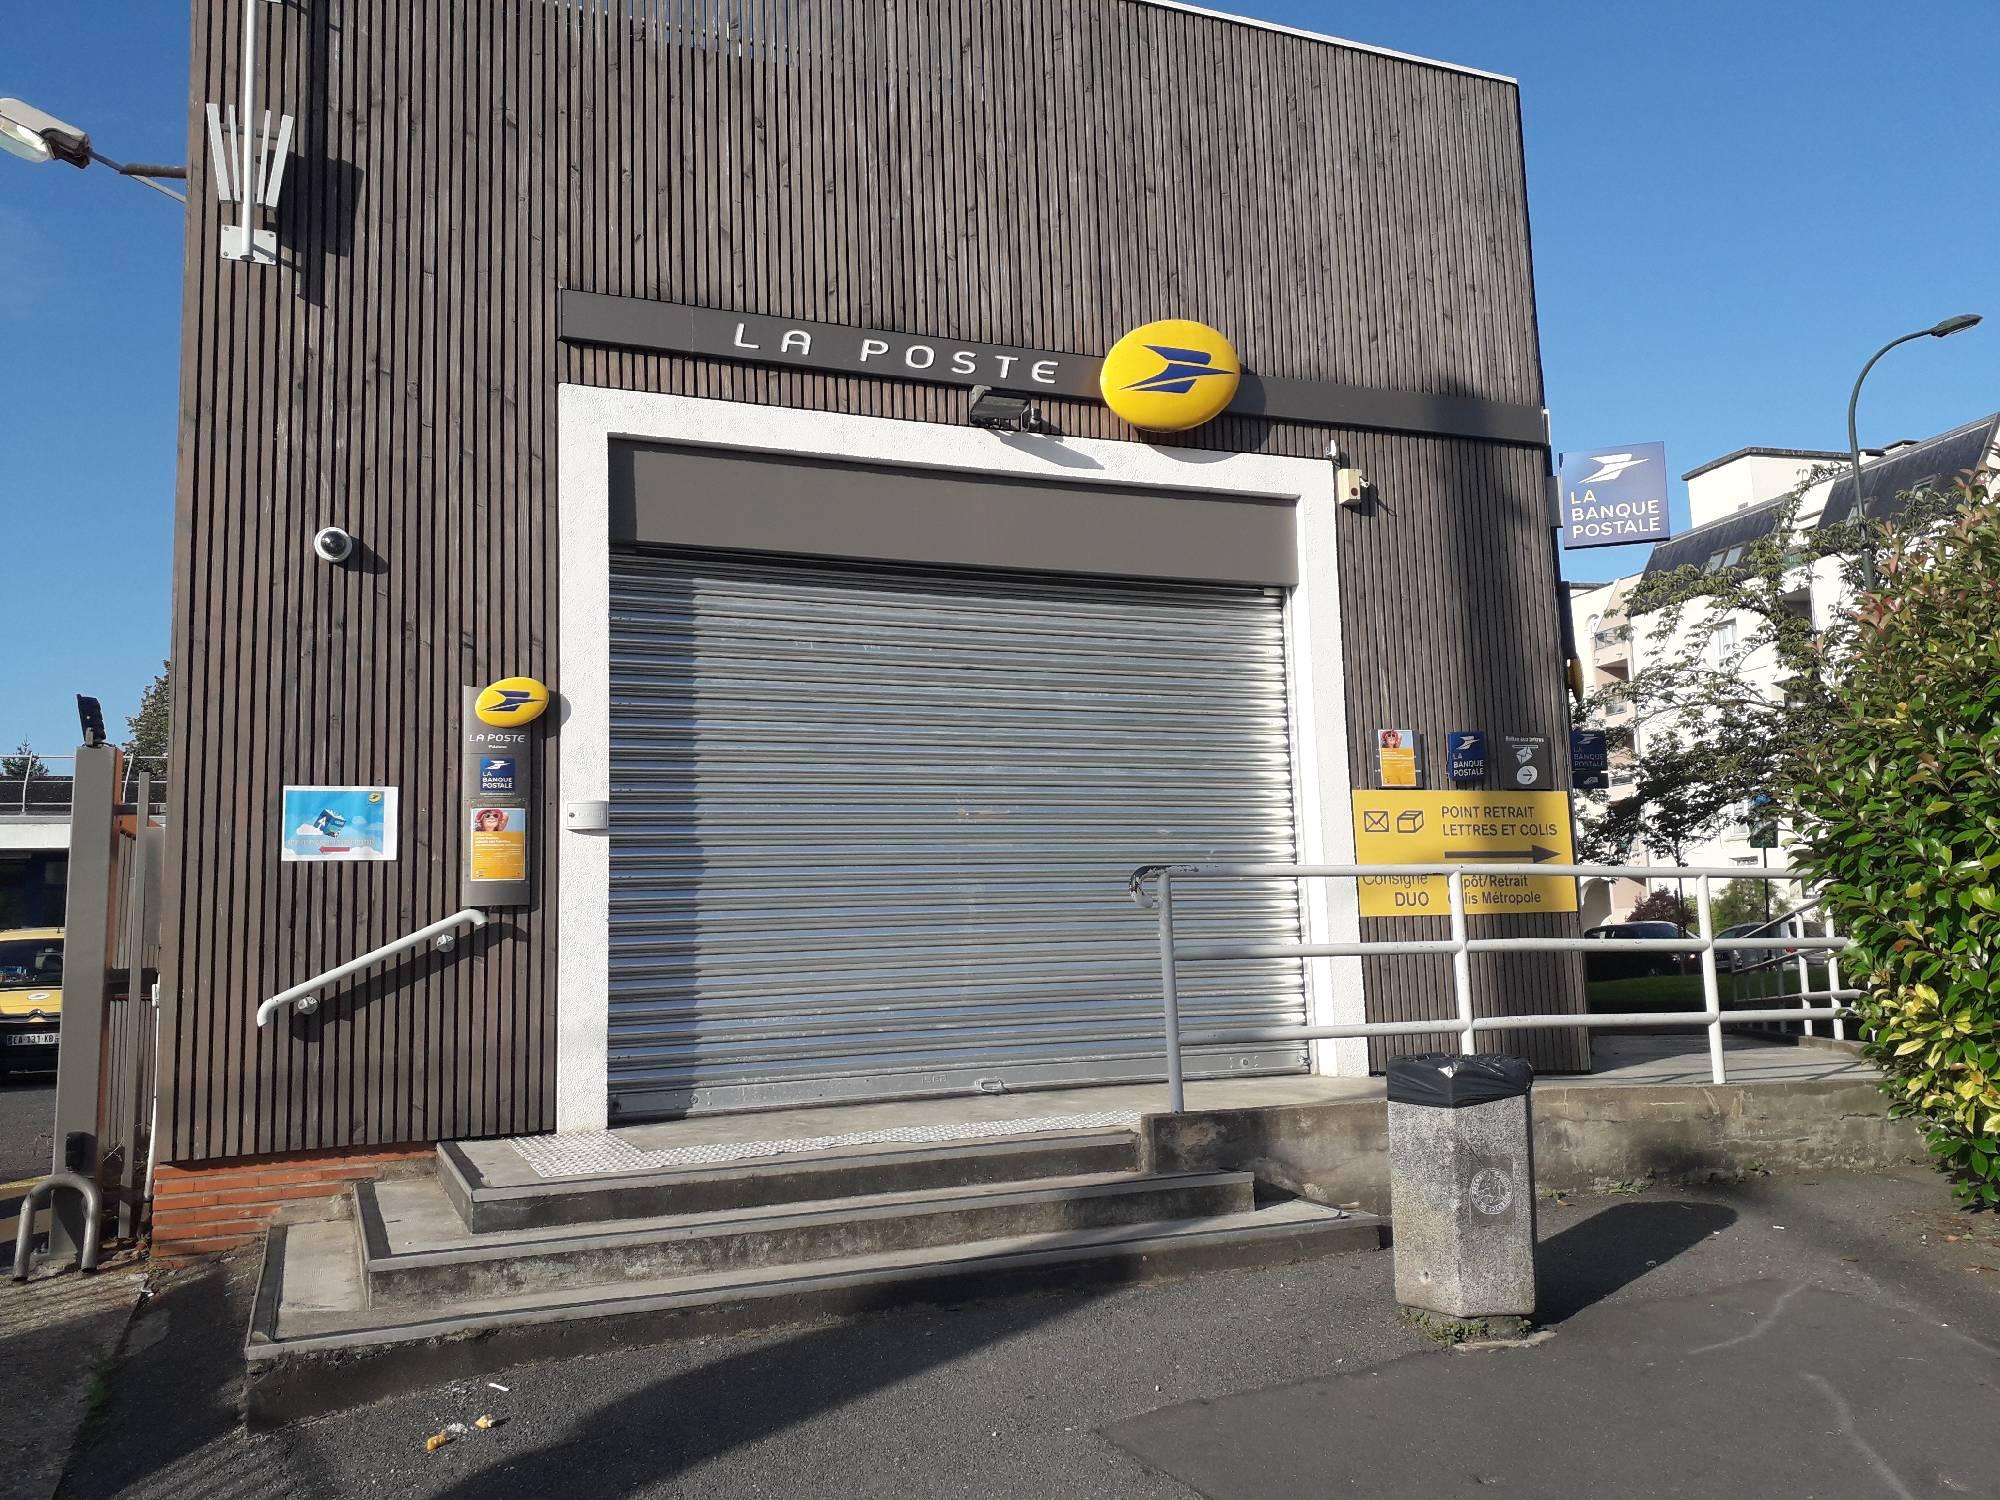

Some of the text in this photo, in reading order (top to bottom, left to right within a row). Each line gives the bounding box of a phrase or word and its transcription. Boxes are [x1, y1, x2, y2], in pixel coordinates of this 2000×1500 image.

[733, 322, 1059, 384] LA POSTE
[1570, 489, 1596, 505] LA
[1571, 500, 1660, 522] BANQUE
[1572, 517, 1661, 539] POSTALE
[469, 734, 526, 743] LA POSTE
[1453, 760, 1484, 769] BANQUE
[1453, 768, 1484, 777] POSTALE
[1442, 806, 1535, 818] POINT RETRAIT
[1442, 823, 1558, 836] LETTRES ET COLIS
[1447, 875, 1528, 890] pôt/Retrait
[1394, 892, 1429, 907] DUO
[1482, 891, 1542, 905] Métropole
